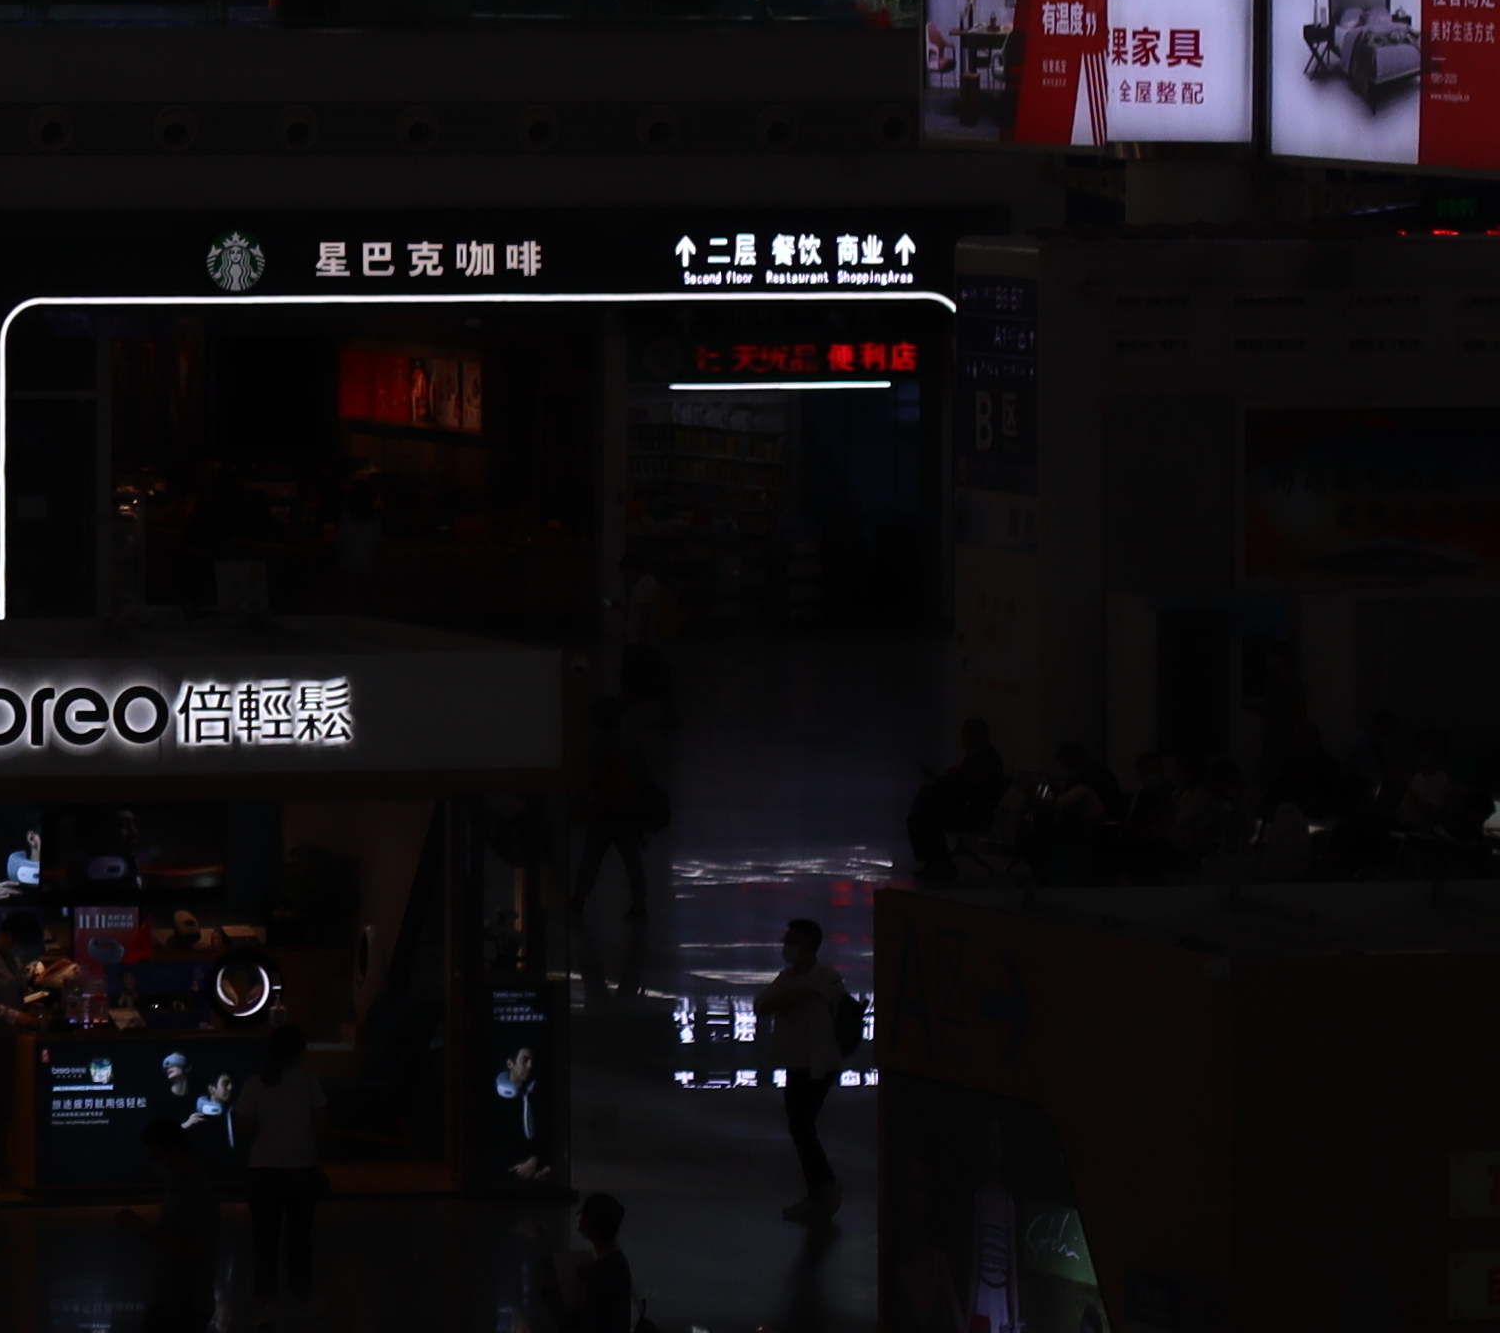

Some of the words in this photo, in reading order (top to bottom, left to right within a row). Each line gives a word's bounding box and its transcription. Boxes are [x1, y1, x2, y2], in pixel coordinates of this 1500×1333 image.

[1430, 20, 1496, 44] 美好生活方式
[1119, 79, 1205, 104] 全屋整配
[314, 240, 542, 277] 星巴克咖啡
[707, 234, 757, 266] 二层
[772, 234, 822, 266] 餐饮
[837, 234, 885, 266] 商业
[684, 271, 722, 285] Second
[726, 271, 754, 284] floor
[766, 271, 830, 284] Restaurant
[825, 341, 920, 372] 便利店
